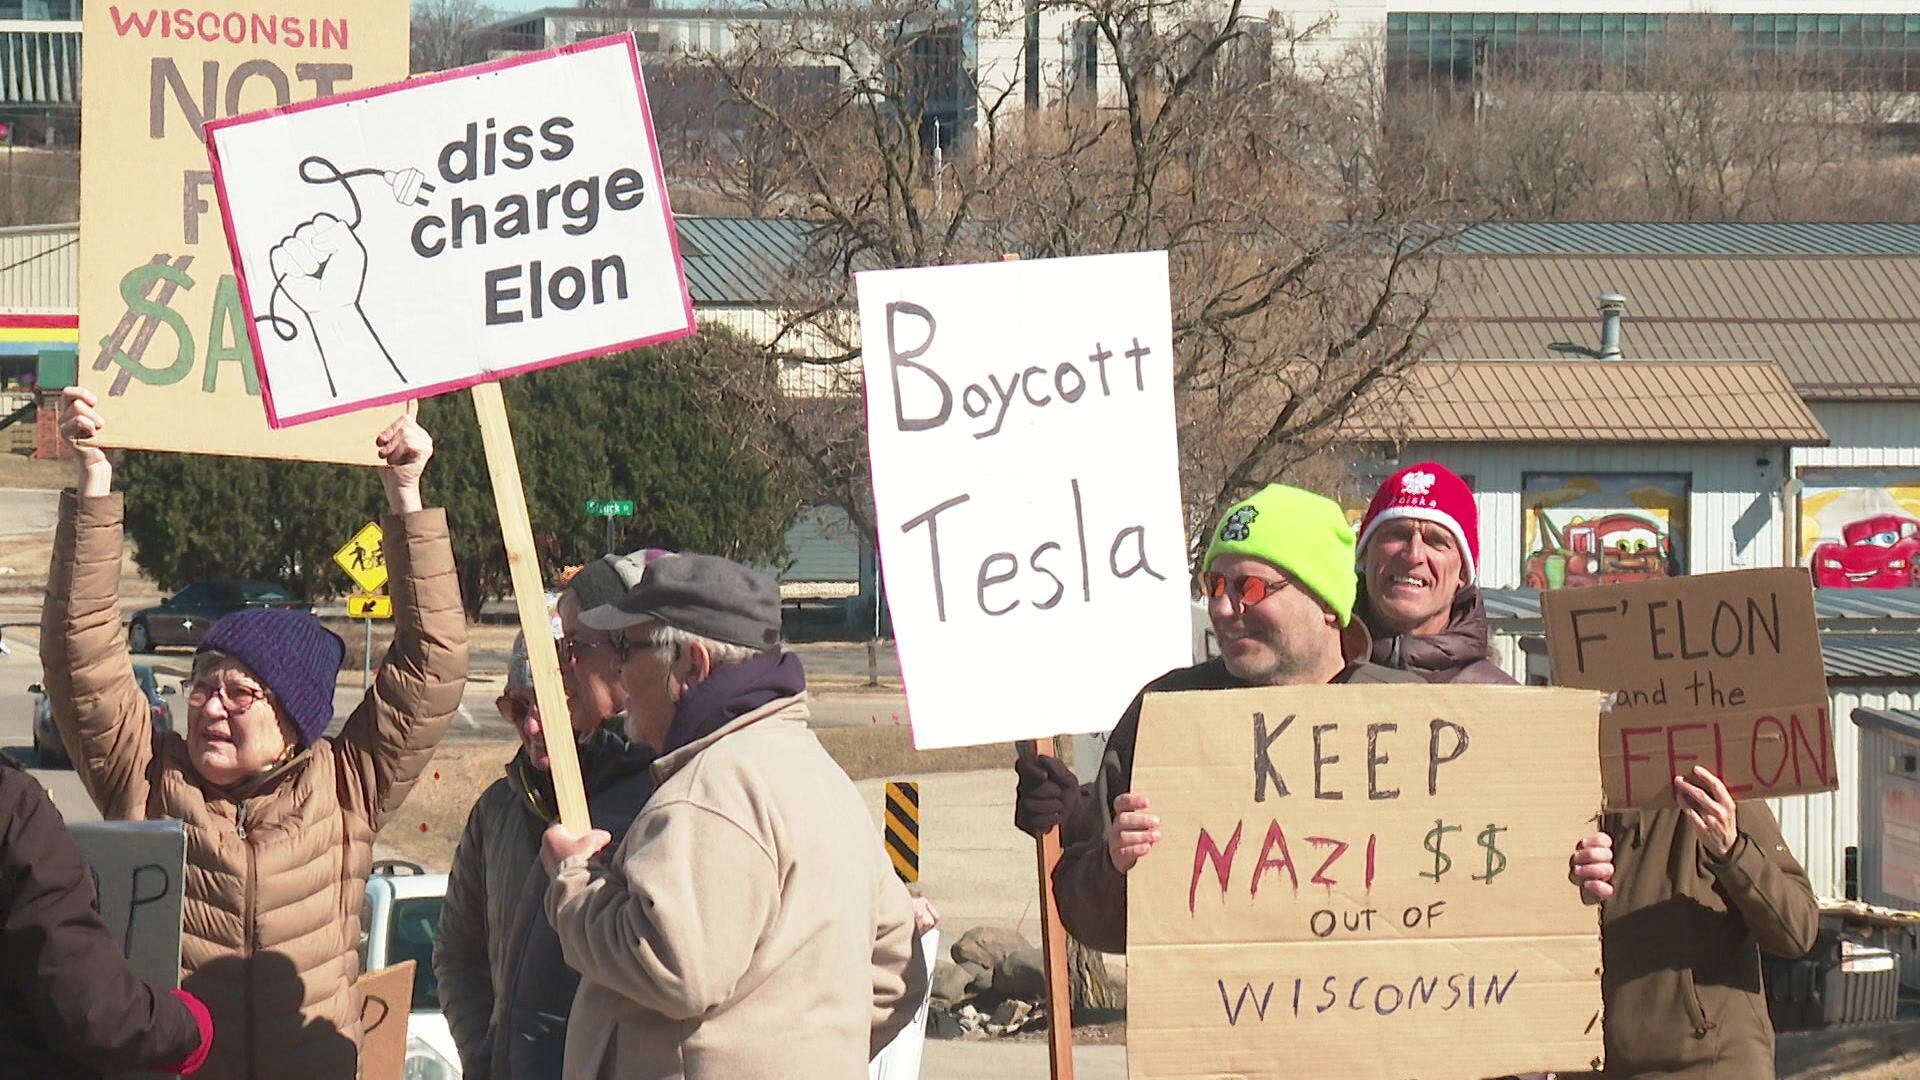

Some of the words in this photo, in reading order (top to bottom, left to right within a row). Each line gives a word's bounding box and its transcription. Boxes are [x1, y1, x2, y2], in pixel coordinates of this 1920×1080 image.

[109, 5, 348, 50] WISCONSIN
[438, 116, 575, 184] diss
[411, 168, 645, 258] charge
[485, 255, 628, 326] Elon
[885, 301, 1152, 440] Boycott
[901, 478, 1167, 622] Tesla
[1570, 592, 1781, 673] F'ELON
[1617, 679, 1668, 706] and
[1685, 671, 1746, 707] the
[1253, 712, 1469, 802] KEEP
[1189, 819, 1376, 918] NAZI
[1419, 819, 1507, 885] $$
[1310, 908, 1378, 937] OUT
[1403, 901, 1446, 927] OF
[1217, 970, 1519, 1026] WISCONSIN
